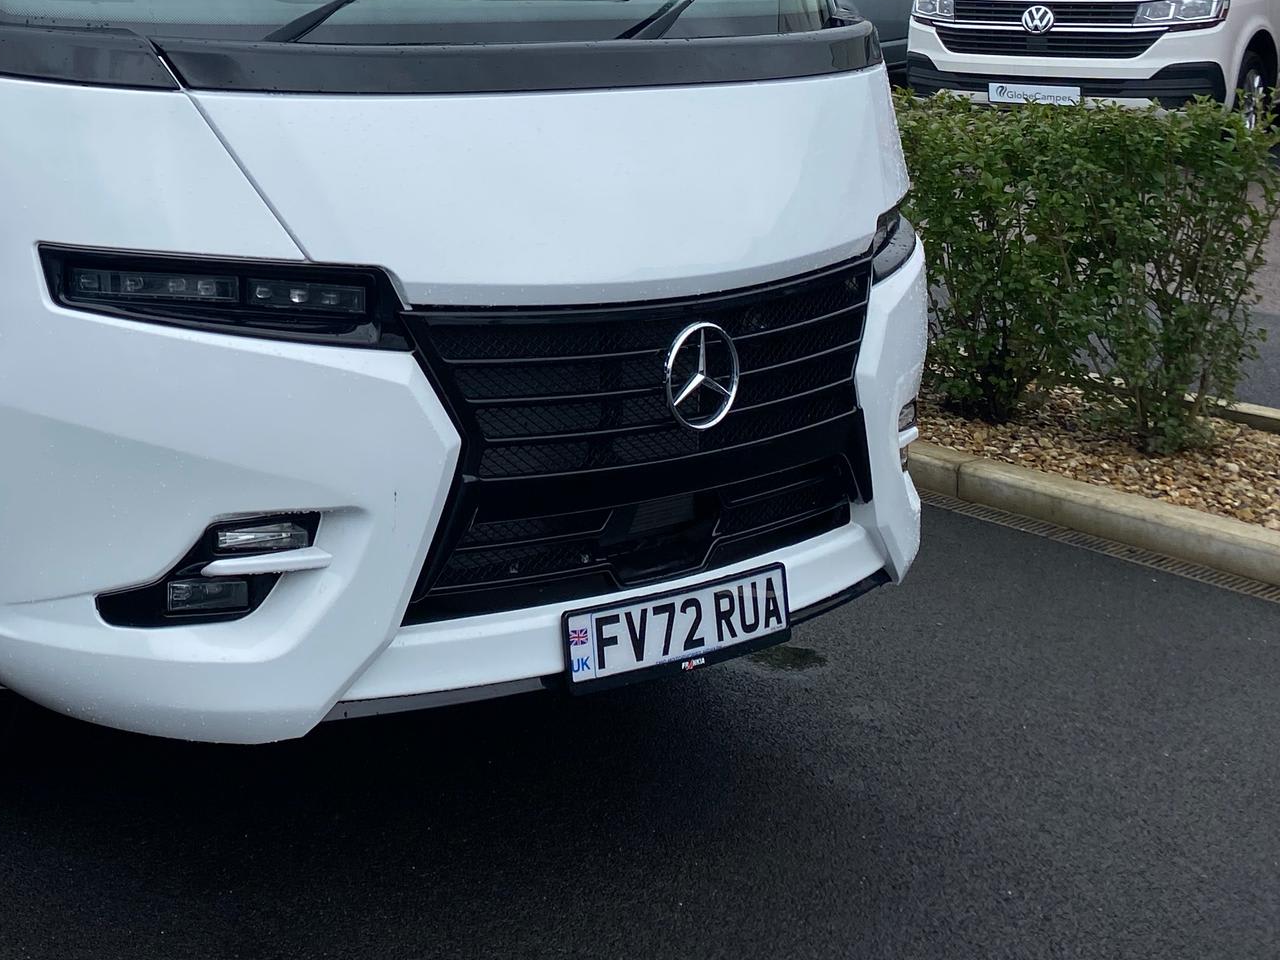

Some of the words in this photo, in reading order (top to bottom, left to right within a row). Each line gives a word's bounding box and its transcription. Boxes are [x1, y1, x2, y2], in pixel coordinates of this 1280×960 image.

[595, 597, 705, 670] FV72
[713, 577, 783, 642] RUA
[571, 656, 591, 673] UK
